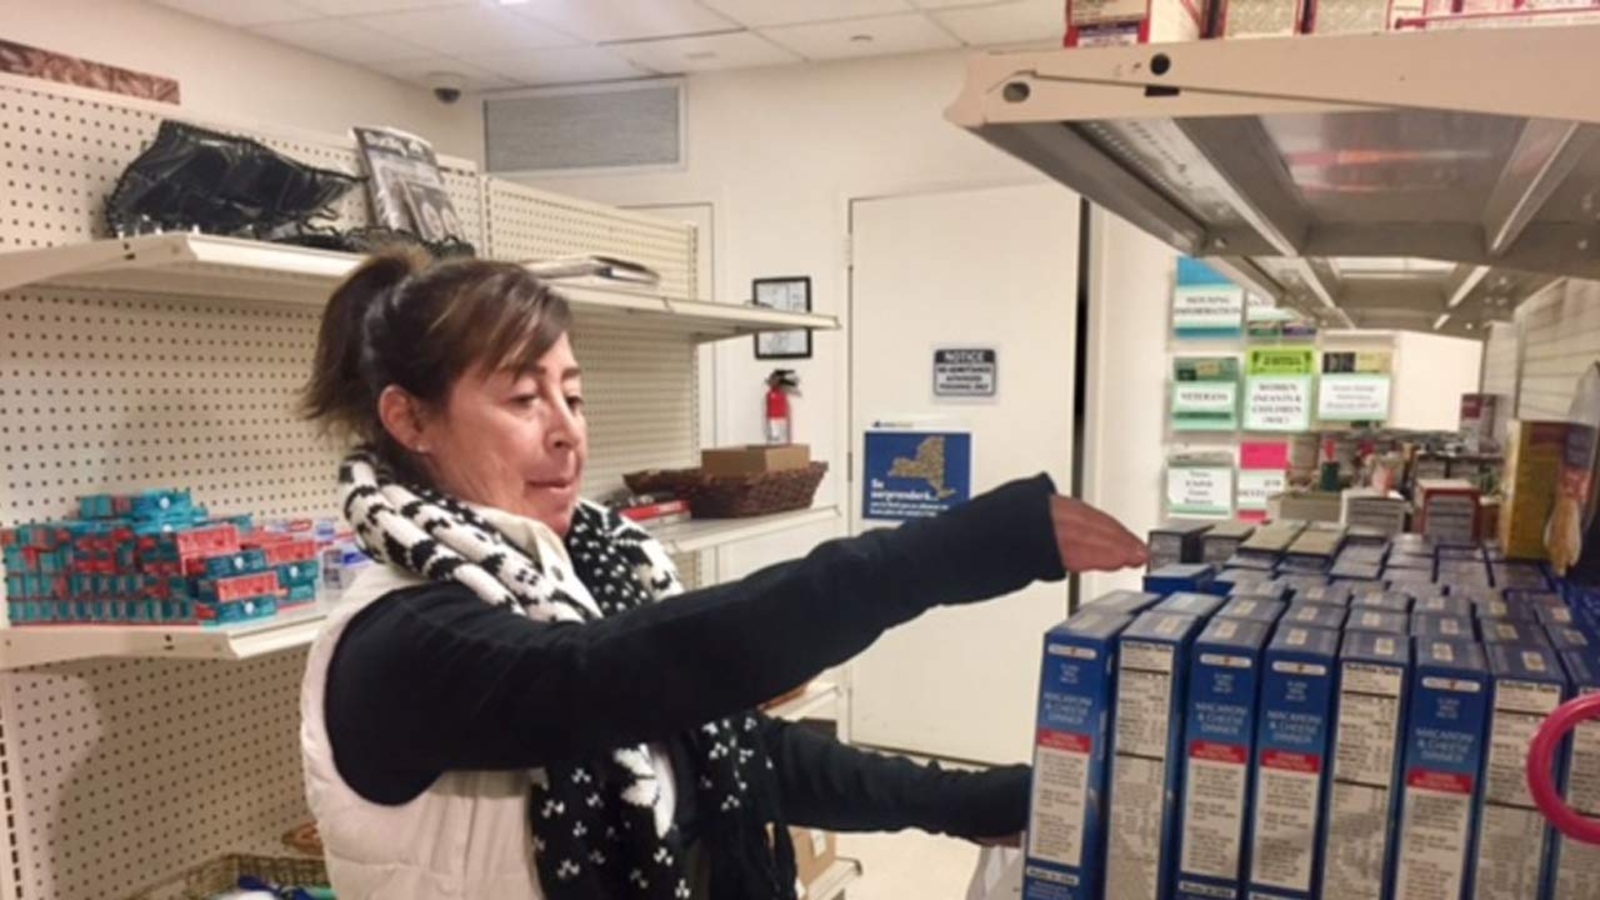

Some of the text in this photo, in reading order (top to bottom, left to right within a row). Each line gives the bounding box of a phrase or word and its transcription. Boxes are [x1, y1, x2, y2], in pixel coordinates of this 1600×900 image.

[1175, 306, 1241, 314] INFORMATION
[945, 351, 984, 363] NOTICE
[1180, 392, 1228, 401] VETERANS
[1251, 405, 1302, 413] CHILDREN
[1043, 692, 1093, 706] MACARONI
[1054, 703, 1089, 717] CHEESE
[1195, 702, 1248, 716] MACARONI
[1208, 714, 1243, 726] CHEESE
[1267, 710, 1323, 724] MACARONI
[1201, 722, 1239, 734] DINNER
[1280, 721, 1318, 735] CHEESE
[1415, 727, 1475, 742] MACARONI
[1273, 731, 1312, 744] DINNER
[1429, 739, 1469, 754] CHEESE
[1420, 749, 1463, 762] DINNER
